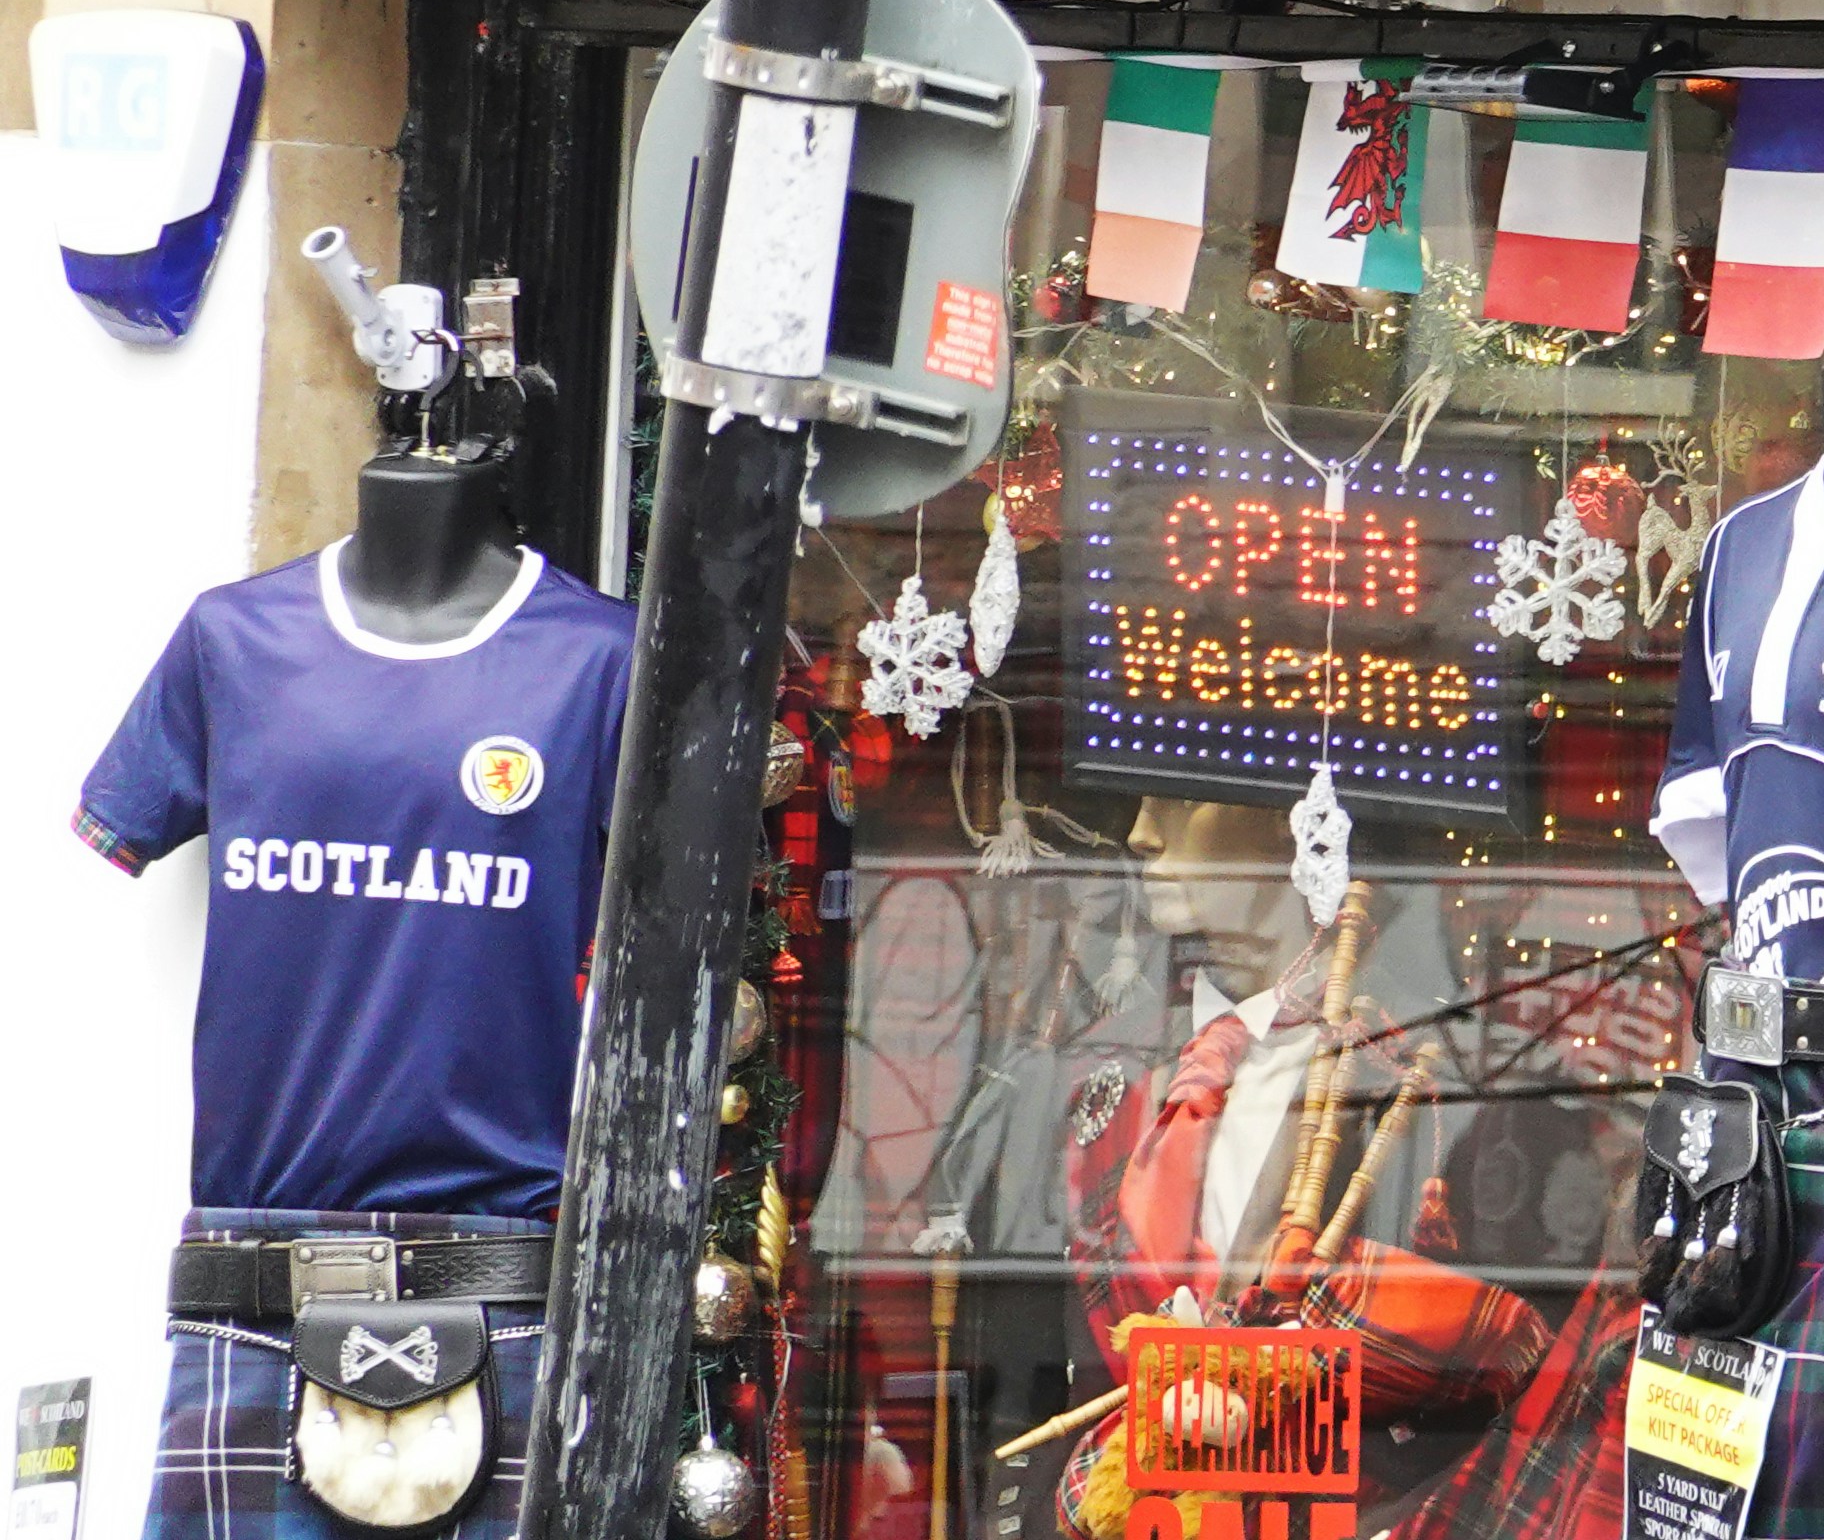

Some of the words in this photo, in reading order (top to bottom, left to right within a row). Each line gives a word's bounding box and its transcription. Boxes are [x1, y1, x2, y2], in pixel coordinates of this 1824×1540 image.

[1165, 495, 1418, 614] OPEN
[1117, 606, 1470, 731] Welcome
[224, 837, 530, 909] SCOTLAND
[1652, 1330, 1676, 1356] WE
[1136, 1342, 1351, 1475] CLEARANCE
[1647, 1383, 1701, 1420] SPECIAL
[1649, 1415, 1677, 1443] KILT
[1681, 1427, 1741, 1467] PACKAGE
[1638, 1489, 1688, 1524] LEATHER
[1666, 1476, 1699, 1503] YARD
[1700, 1486, 1728, 1511] KILT
